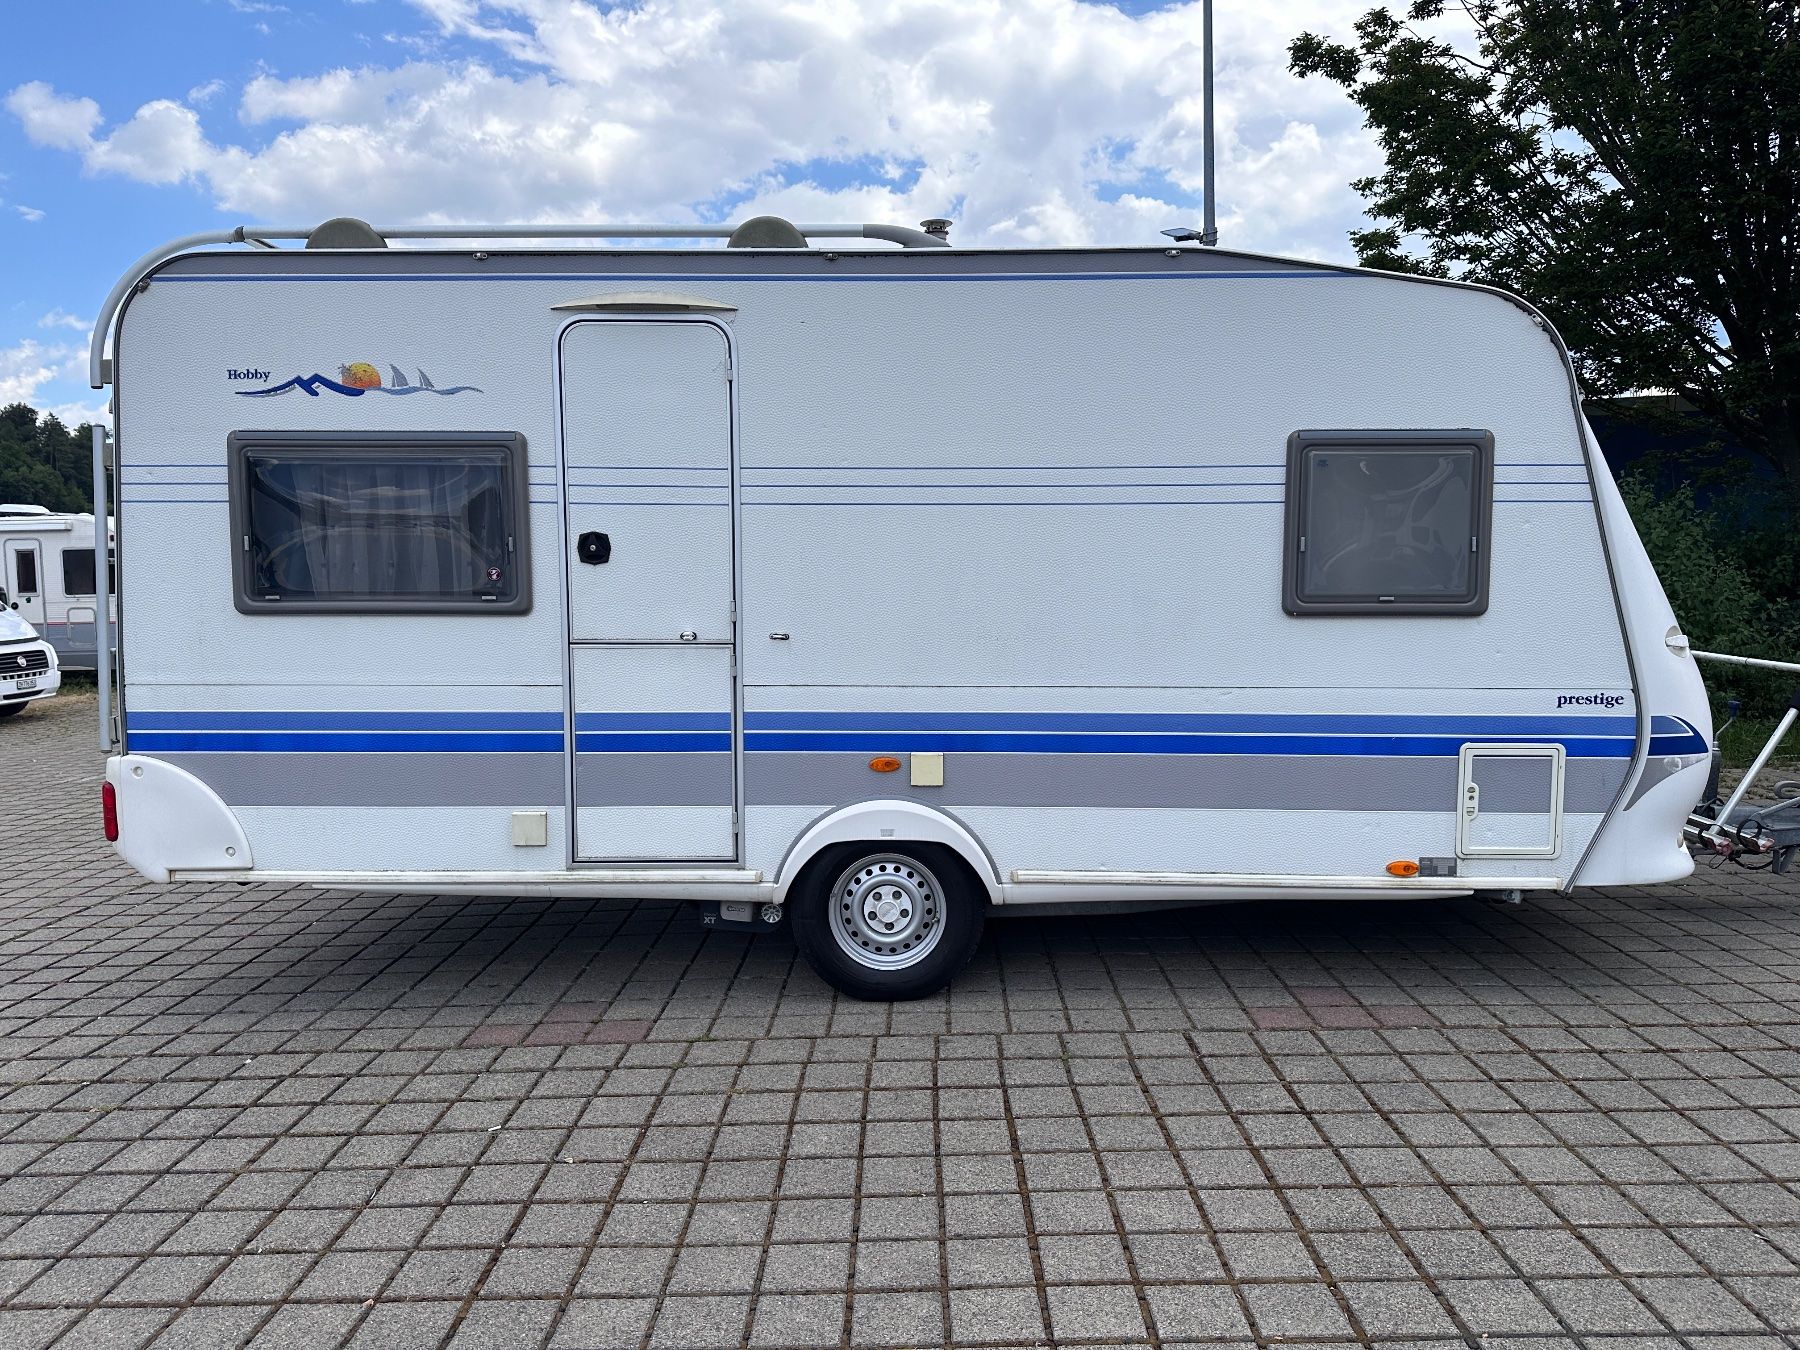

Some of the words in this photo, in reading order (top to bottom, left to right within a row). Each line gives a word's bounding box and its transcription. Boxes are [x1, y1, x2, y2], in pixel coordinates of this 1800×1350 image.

[227, 368, 270, 382] Hobby
[1557, 693, 1624, 708] prestige
[703, 916, 717, 924] XT
